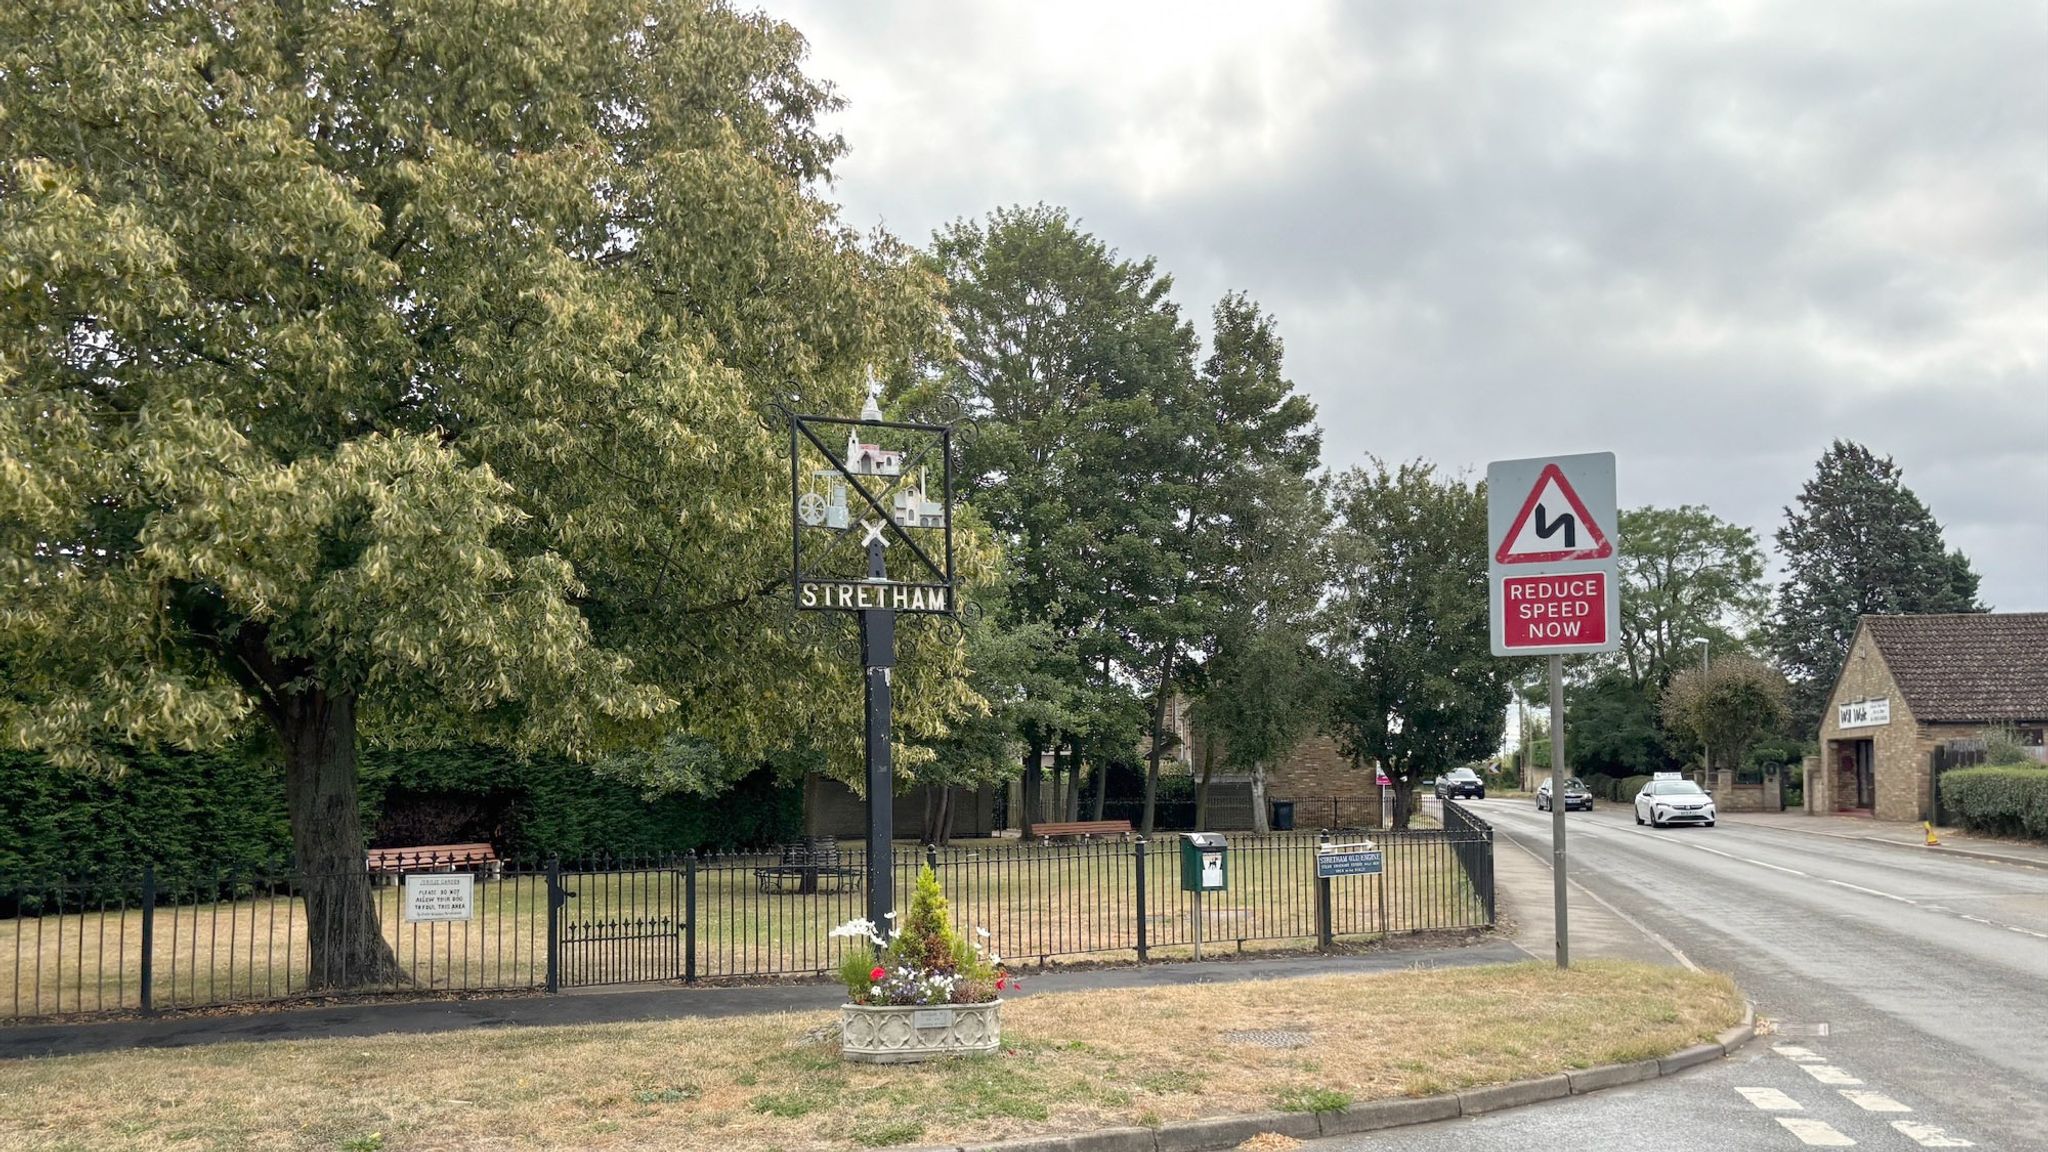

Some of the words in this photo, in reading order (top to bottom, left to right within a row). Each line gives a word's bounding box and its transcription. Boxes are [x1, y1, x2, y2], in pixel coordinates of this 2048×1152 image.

[801, 583, 945, 611] STRETHAM
[1510, 580, 1597, 600] REDUCE
[1520, 601, 1589, 619] SPEED
[1529, 621, 1581, 638] NOW
